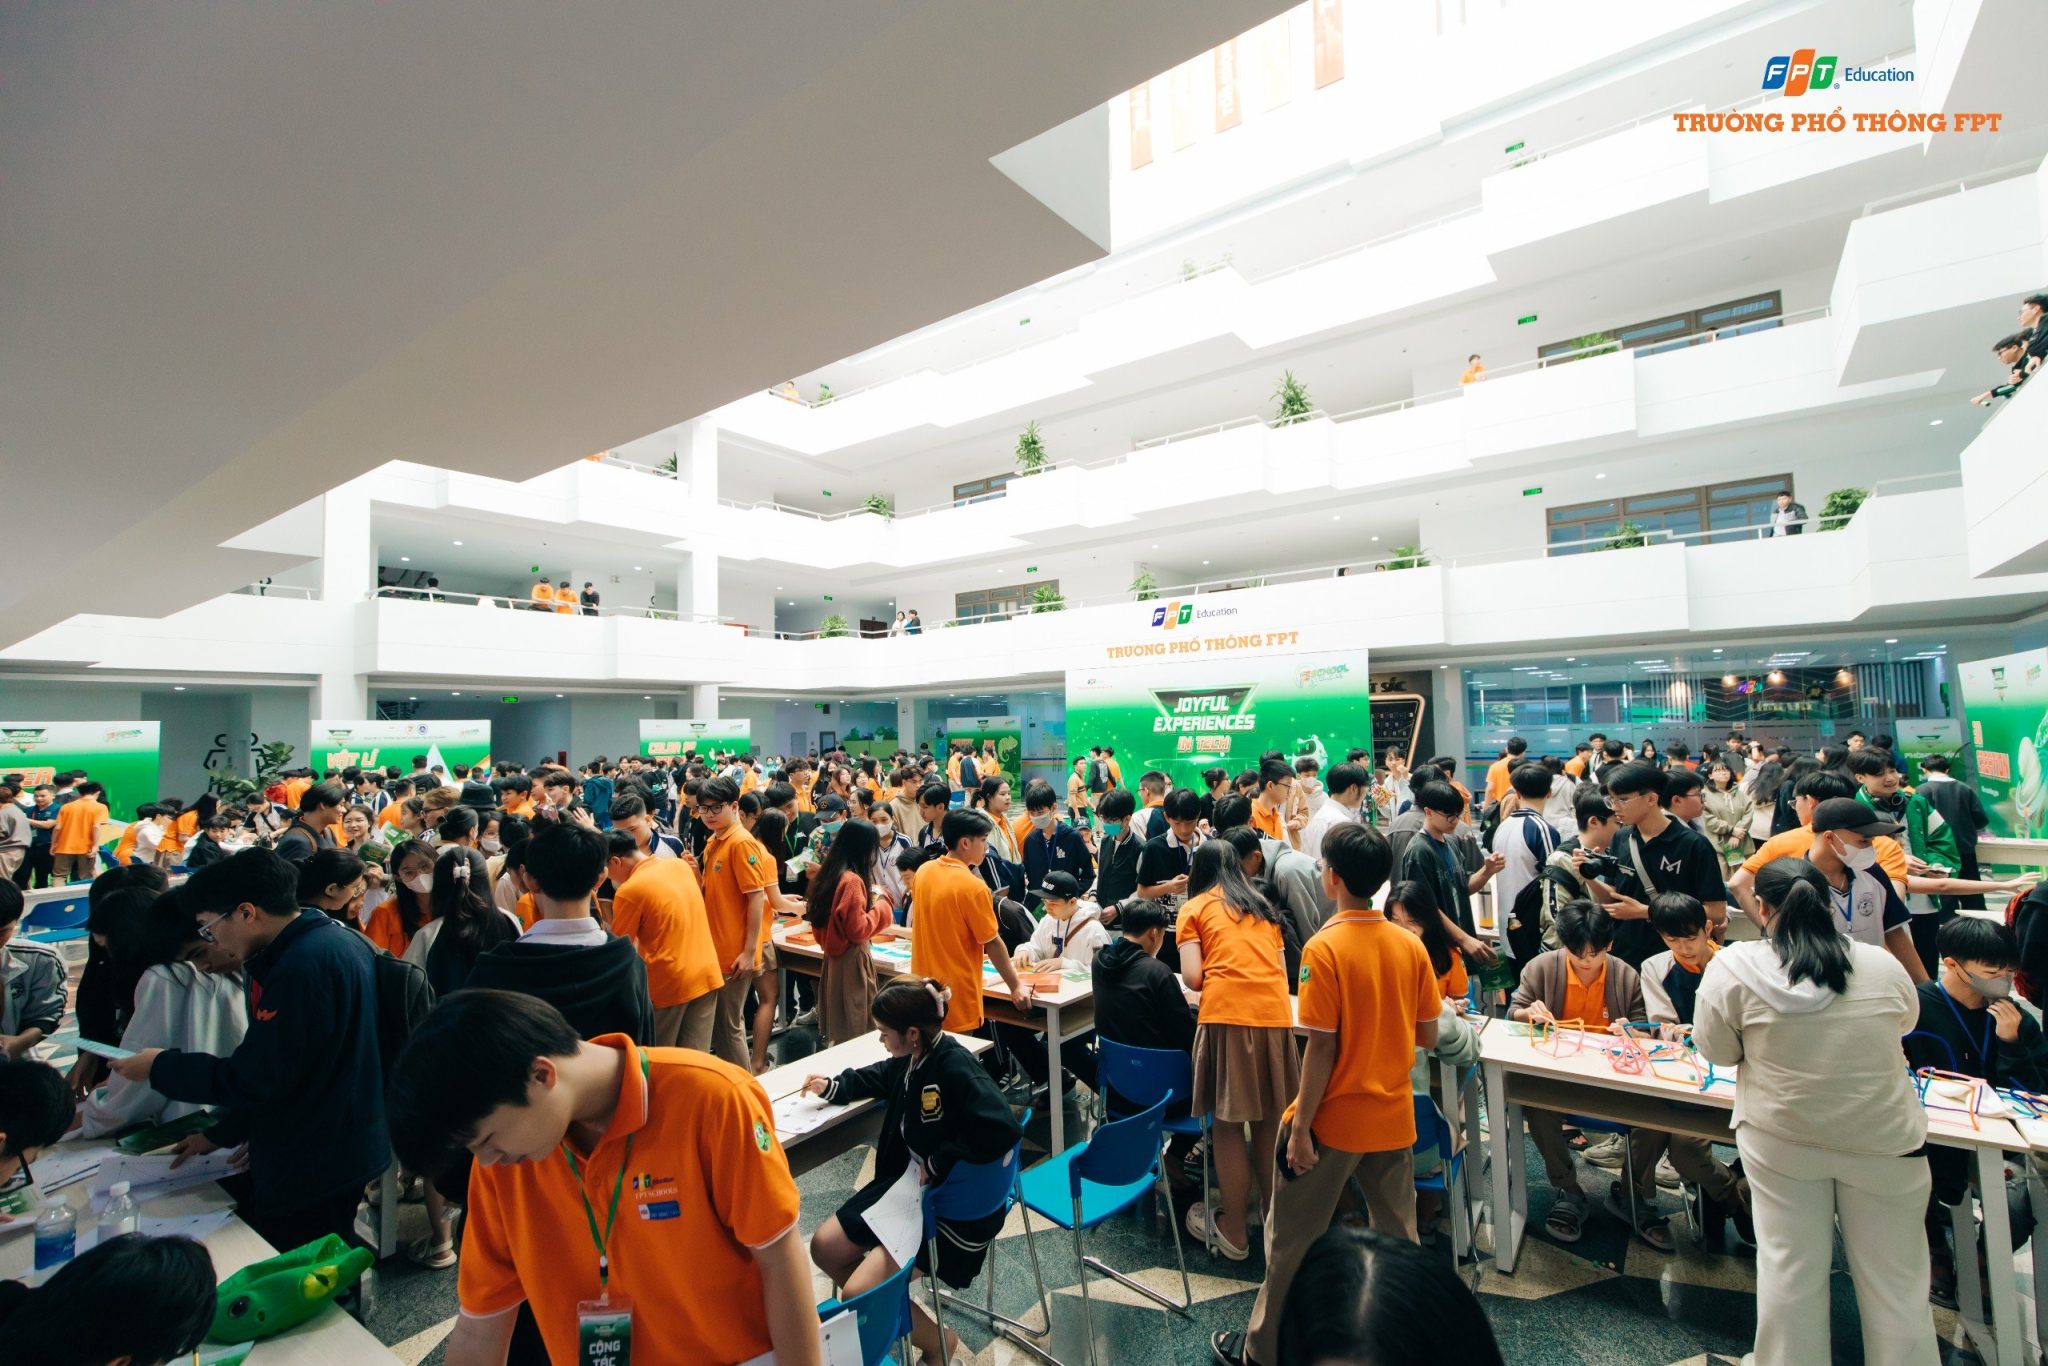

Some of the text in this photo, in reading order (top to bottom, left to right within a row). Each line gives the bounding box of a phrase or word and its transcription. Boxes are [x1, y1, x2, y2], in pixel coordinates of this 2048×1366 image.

[1196, 606, 1238, 619] Education
[1204, 633, 1263, 652] THÔNG
[1265, 631, 1299, 647] FPT
[1173, 695, 1230, 714] JOYFUL
[1153, 714, 1257, 734] EXPERIENCES
[1177, 735, 1232, 753] IN TECH
[588, 1339, 621, 1357] CỘNG
